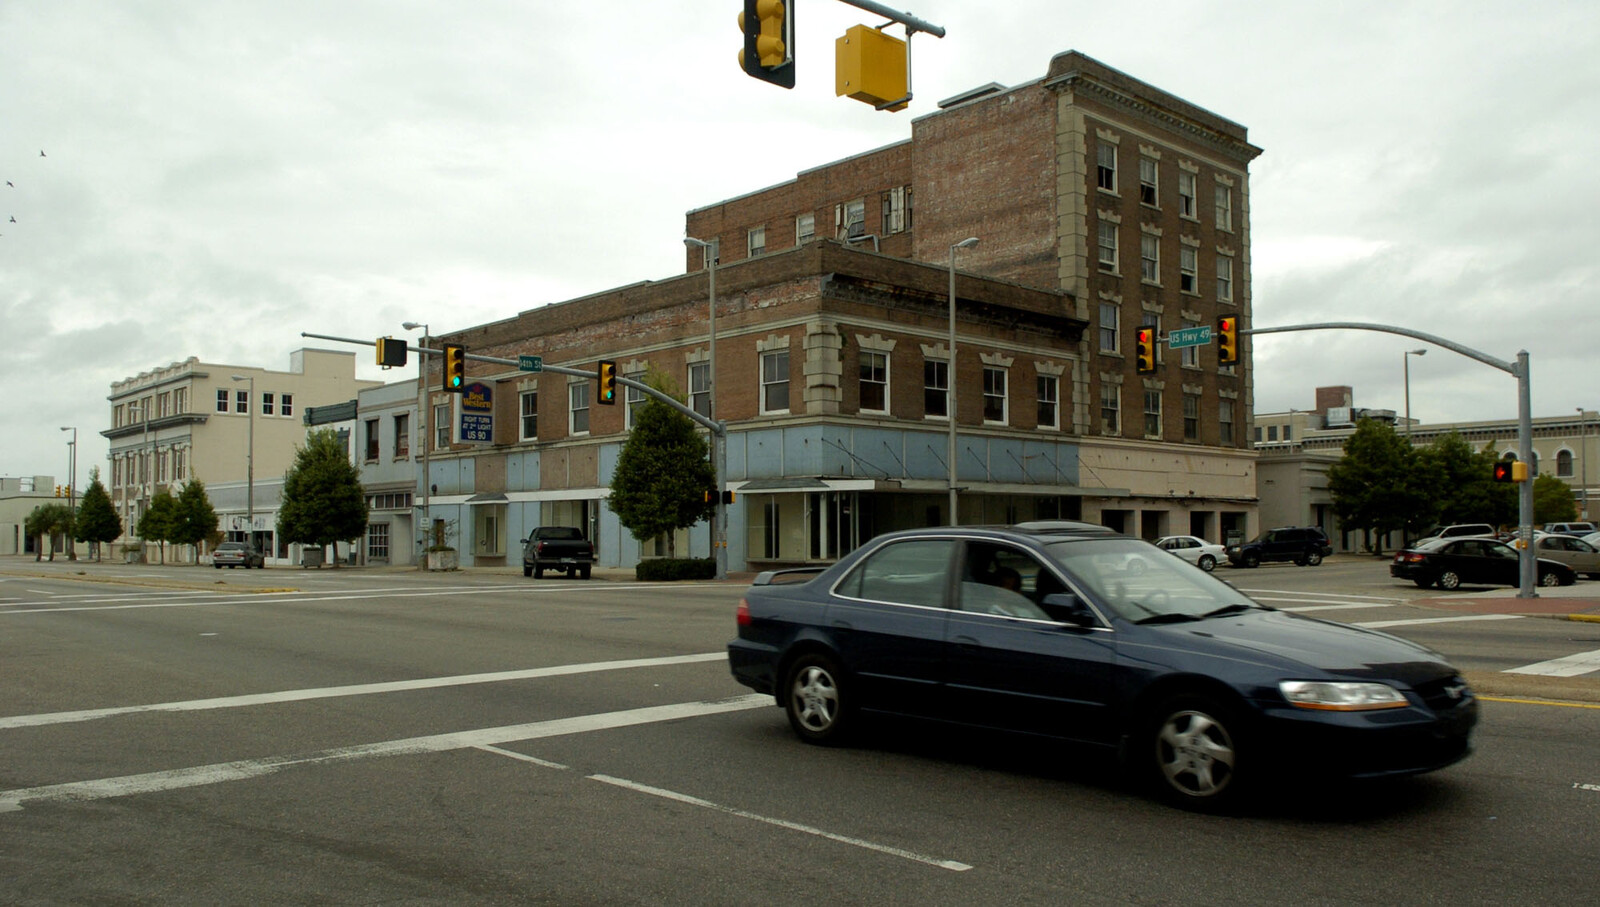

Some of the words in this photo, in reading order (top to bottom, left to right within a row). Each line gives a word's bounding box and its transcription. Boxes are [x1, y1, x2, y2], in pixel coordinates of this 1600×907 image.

[1170, 334, 1180, 343] US
[1182, 332, 1198, 342] Hwy
[1200, 329, 1210, 339] 49
[534, 360, 541, 369] St
[469, 391, 484, 400] Best
[463, 398, 491, 408] Western
[467, 430, 476, 439] US
[477, 431, 486, 440] 90
